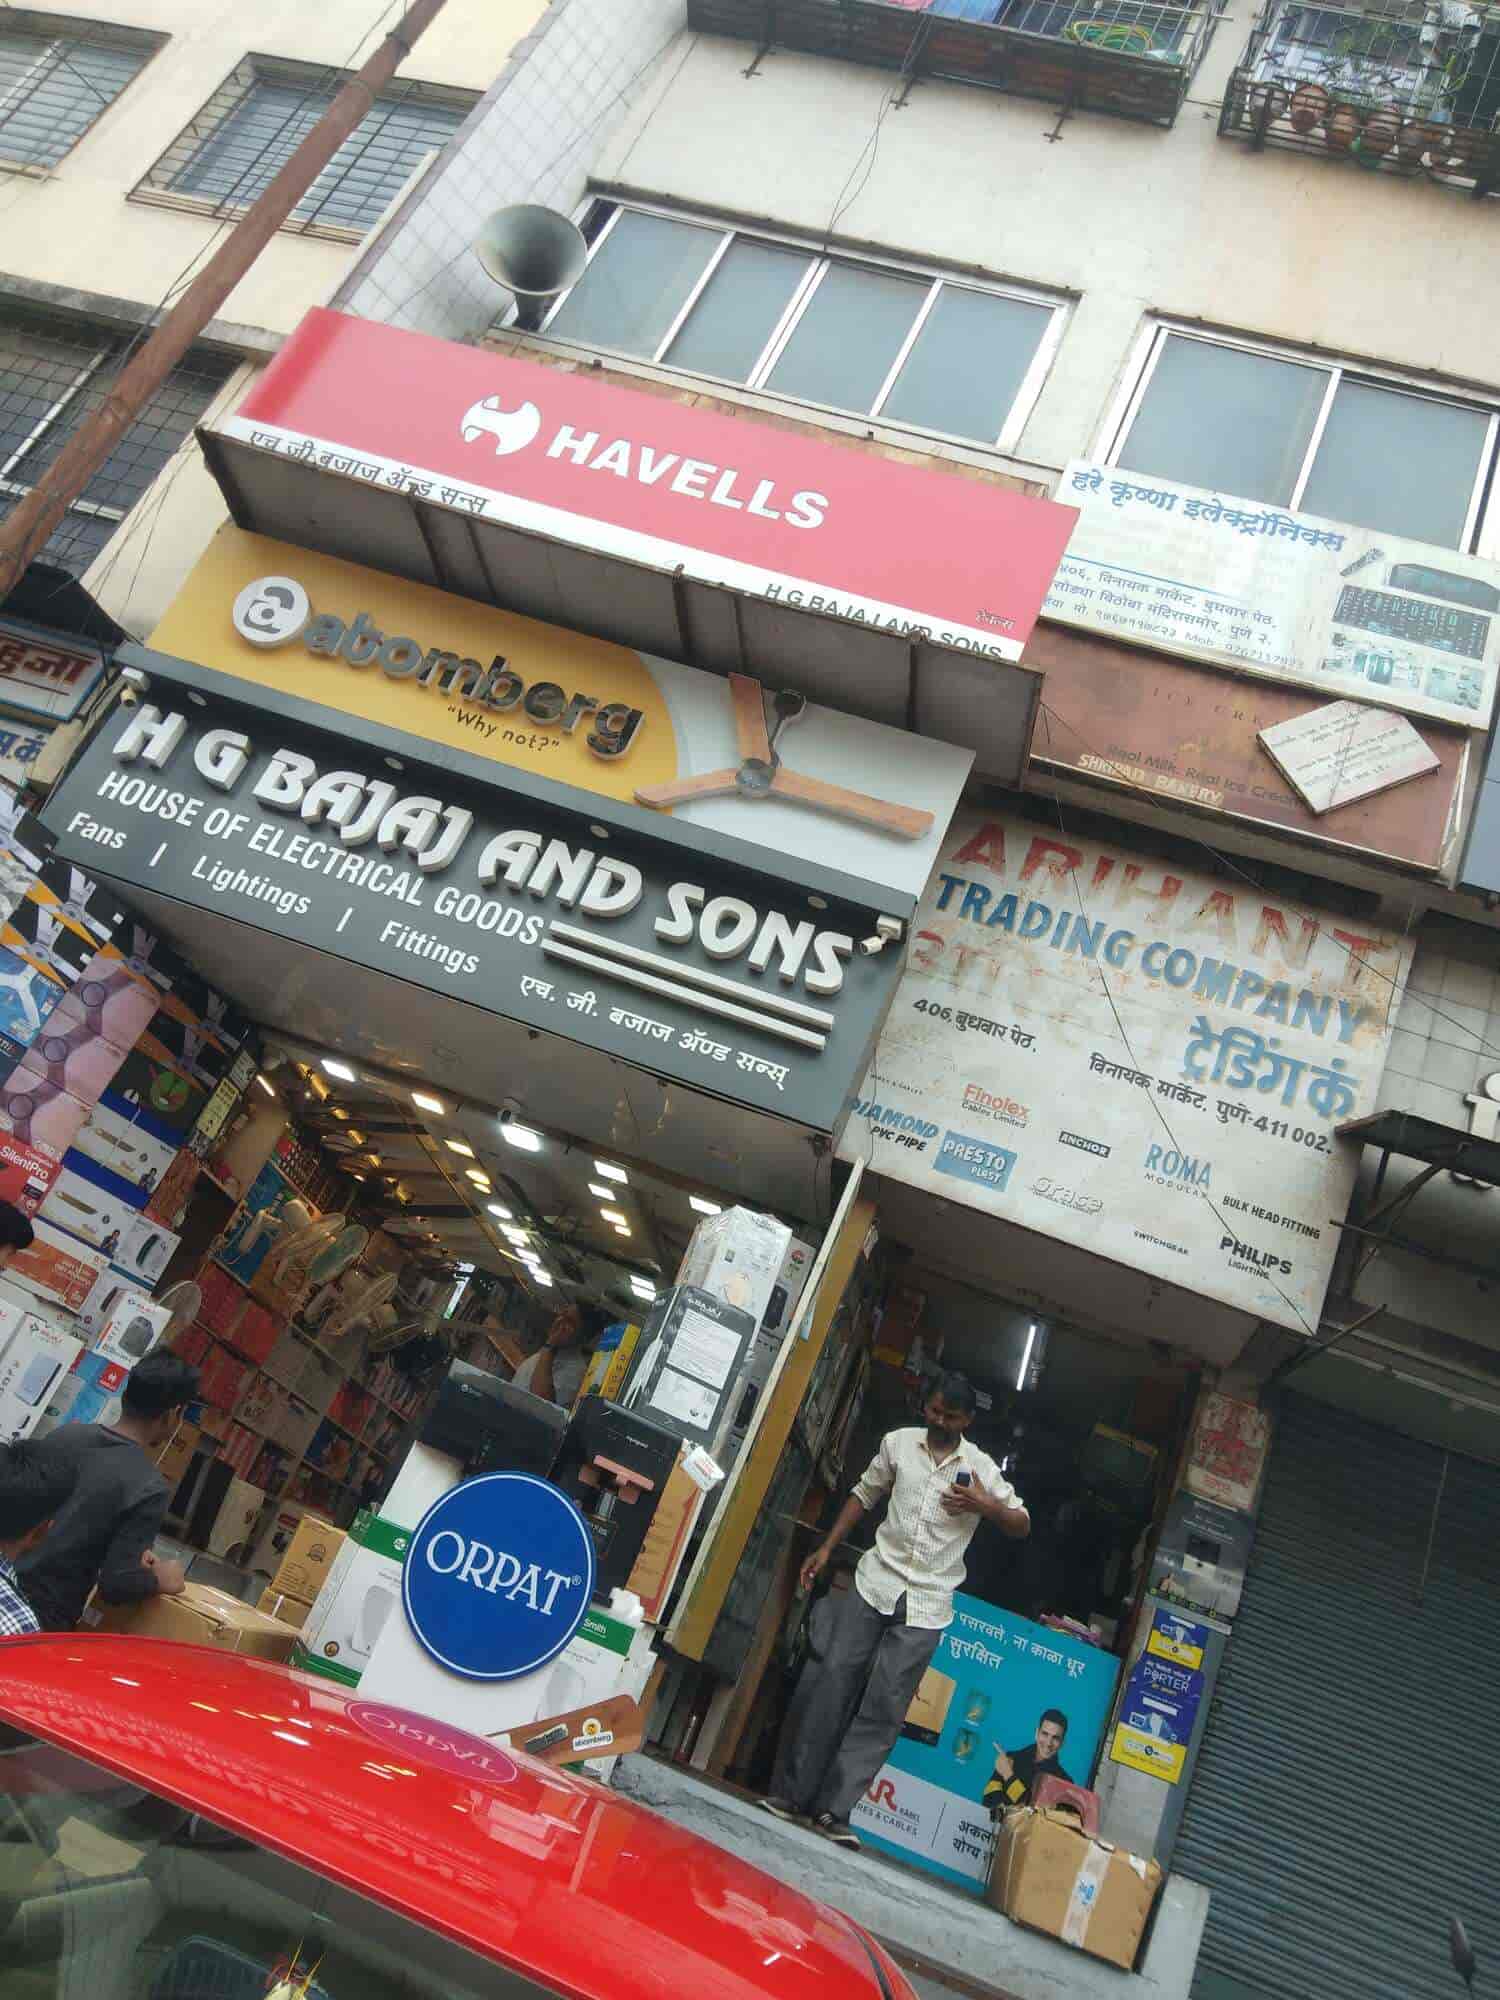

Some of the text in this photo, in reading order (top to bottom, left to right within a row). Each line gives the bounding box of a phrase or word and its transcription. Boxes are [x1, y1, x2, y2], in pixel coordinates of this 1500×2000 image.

[320, 451, 385, 482] बजाज
[545, 425, 829, 528] HAVELLS
[1071, 469, 1104, 494] हरे
[1110, 480, 1179, 511] कृष्णा
[302, 610, 645, 761] atomberg
[96, 770, 548, 948] HOUSE OF ELECTRICAL GOODS
[112, 703, 188, 769] H
[192, 727, 251, 792] G
[252, 746, 476, 874] BAJAJ
[477, 829, 644, 918] AND
[654, 881, 854, 995] SONS
[67, 811, 128, 851] Fans
[191, 854, 313, 918] Lightings
[379, 919, 482, 974] Fittings
[932, 873, 1138, 968] TRADING
[1141, 941, 1377, 1044] COMPANY
[518, 974, 557, 1002] एच.
[566, 989, 599, 1018] जी.
[608, 1005, 676, 1044] बजाज
[1087, 1051, 1156, 1091] विनायक
[963, 1082, 1032, 1121] Finolex
[870, 1125, 929, 1152] PVC PIPE
[942, 1138, 1008, 1172] PRESTO
[1060, 1131, 1111, 1158] ANCHOR
[1143, 1142, 1214, 1188] ROMA
[1222, 1194, 1321, 1241] BULK HEAD FITTING
[1219, 1235, 1293, 1276] PHILIPS
[426, 1531, 571, 1617] ORPAT
[949, 1636, 1004, 1671] सुरक्षित
[1142, 1665, 1191, 1697] PORTER
